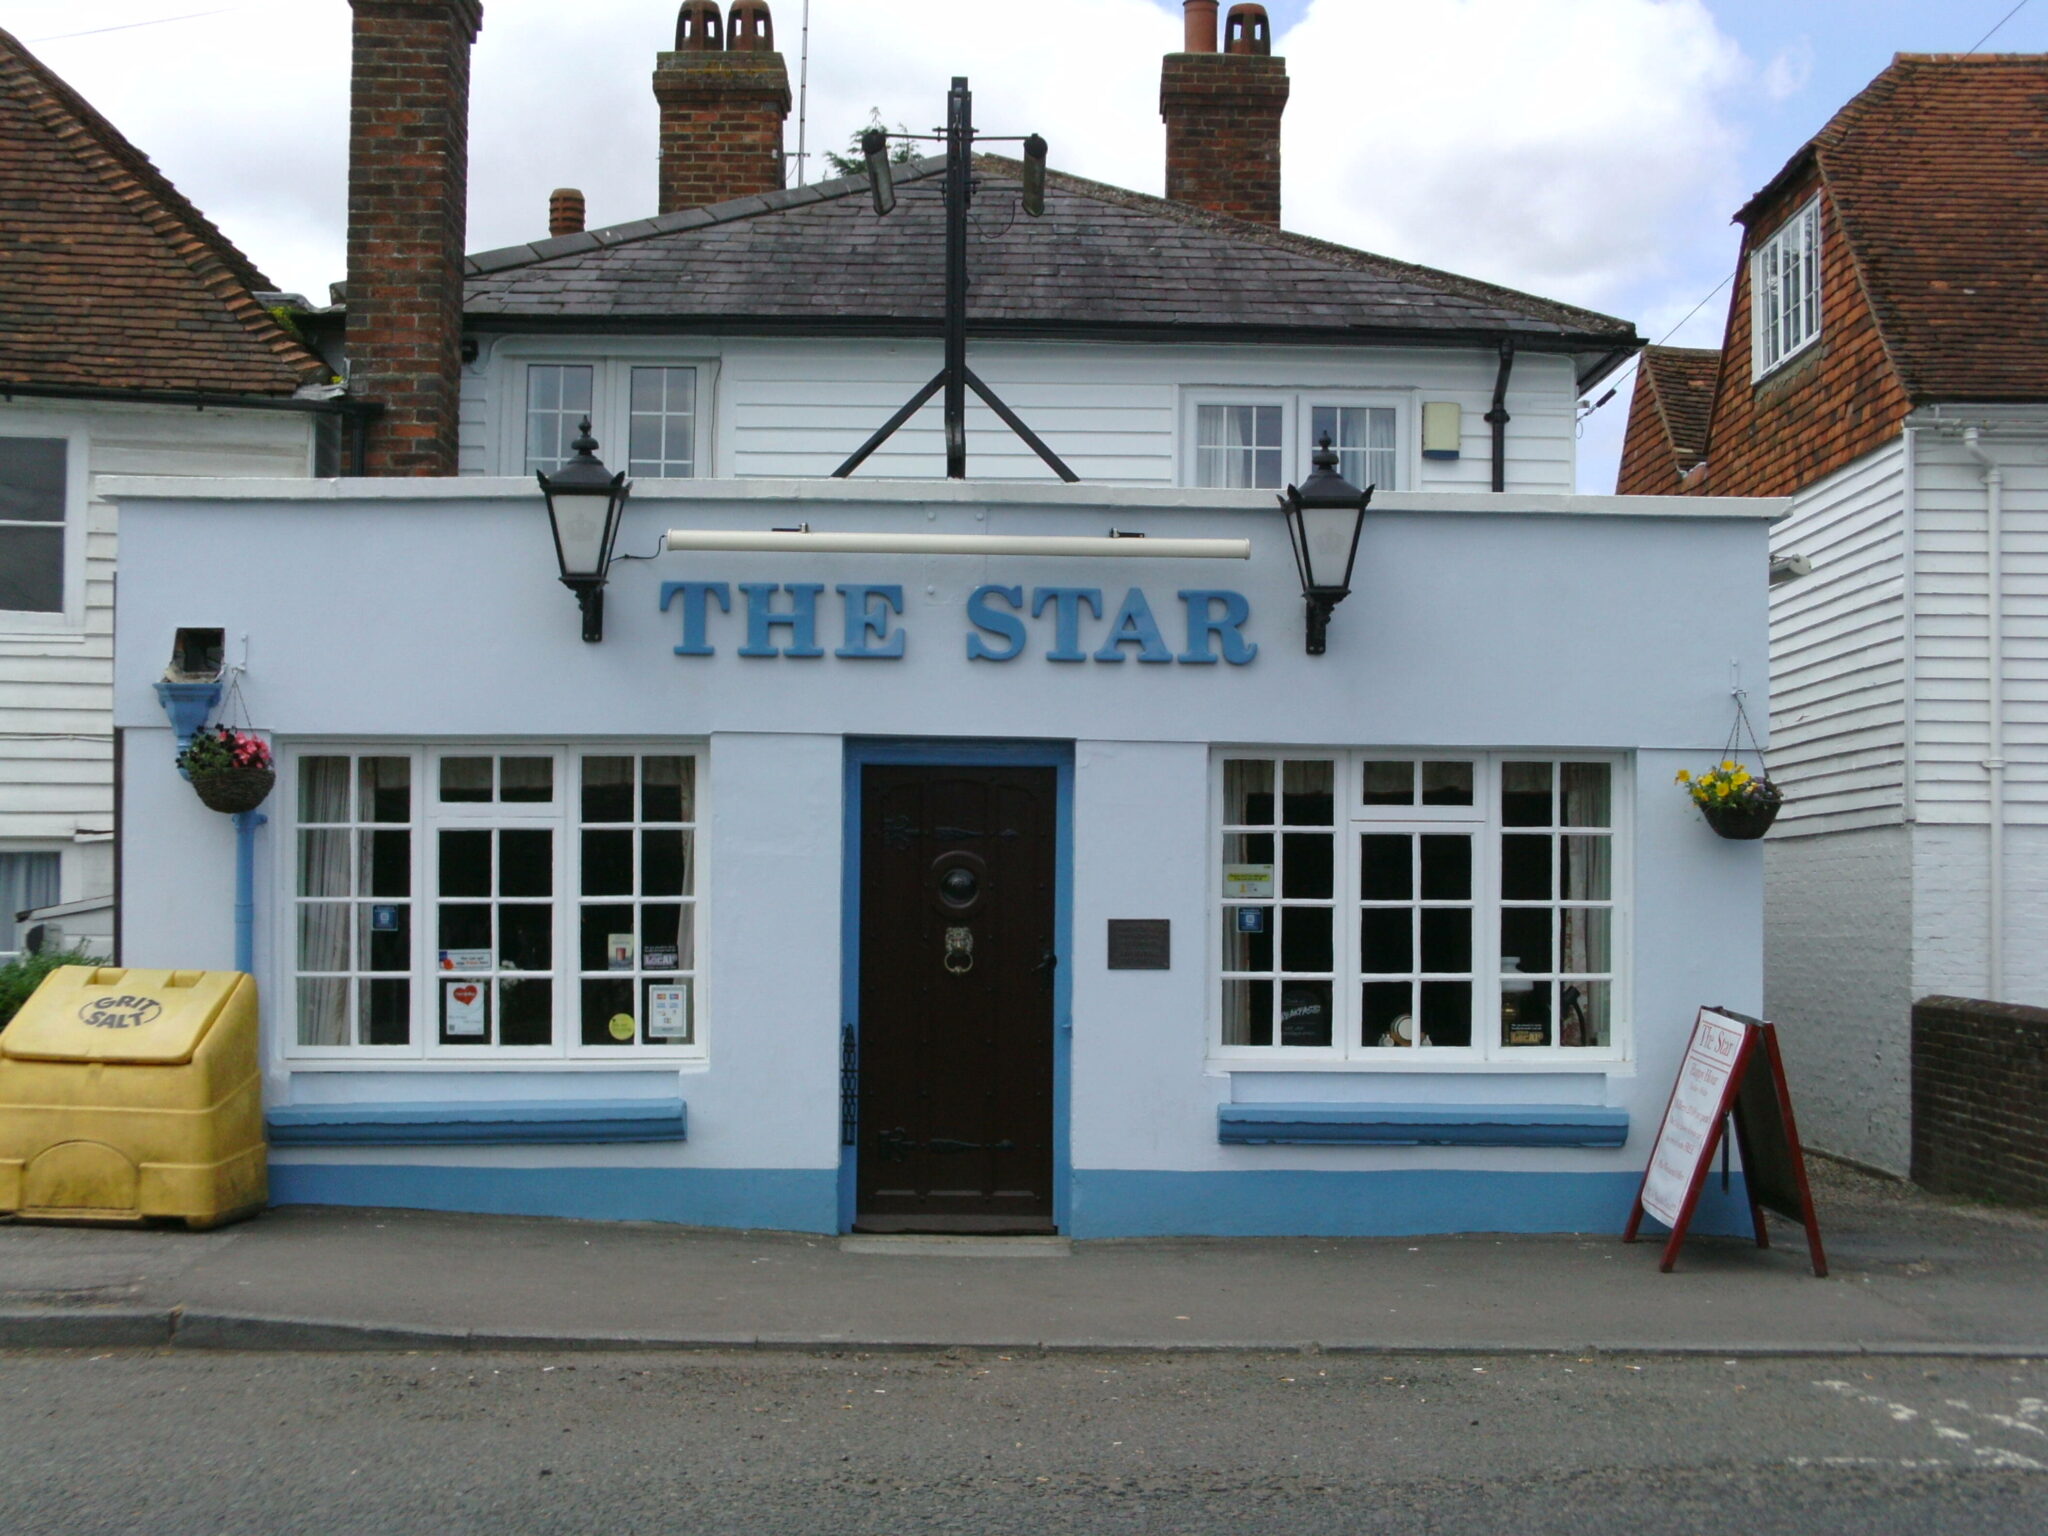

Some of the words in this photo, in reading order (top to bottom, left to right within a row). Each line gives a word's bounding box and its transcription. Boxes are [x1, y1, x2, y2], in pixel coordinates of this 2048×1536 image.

[659, 581, 905, 659] THE
[966, 584, 1259, 665] STAR
[94, 995, 160, 1012] GRIT
[84, 1011, 145, 1029] SALT
[1699, 1024, 1715, 1050] The
[1714, 1030, 1734, 1057] Star
